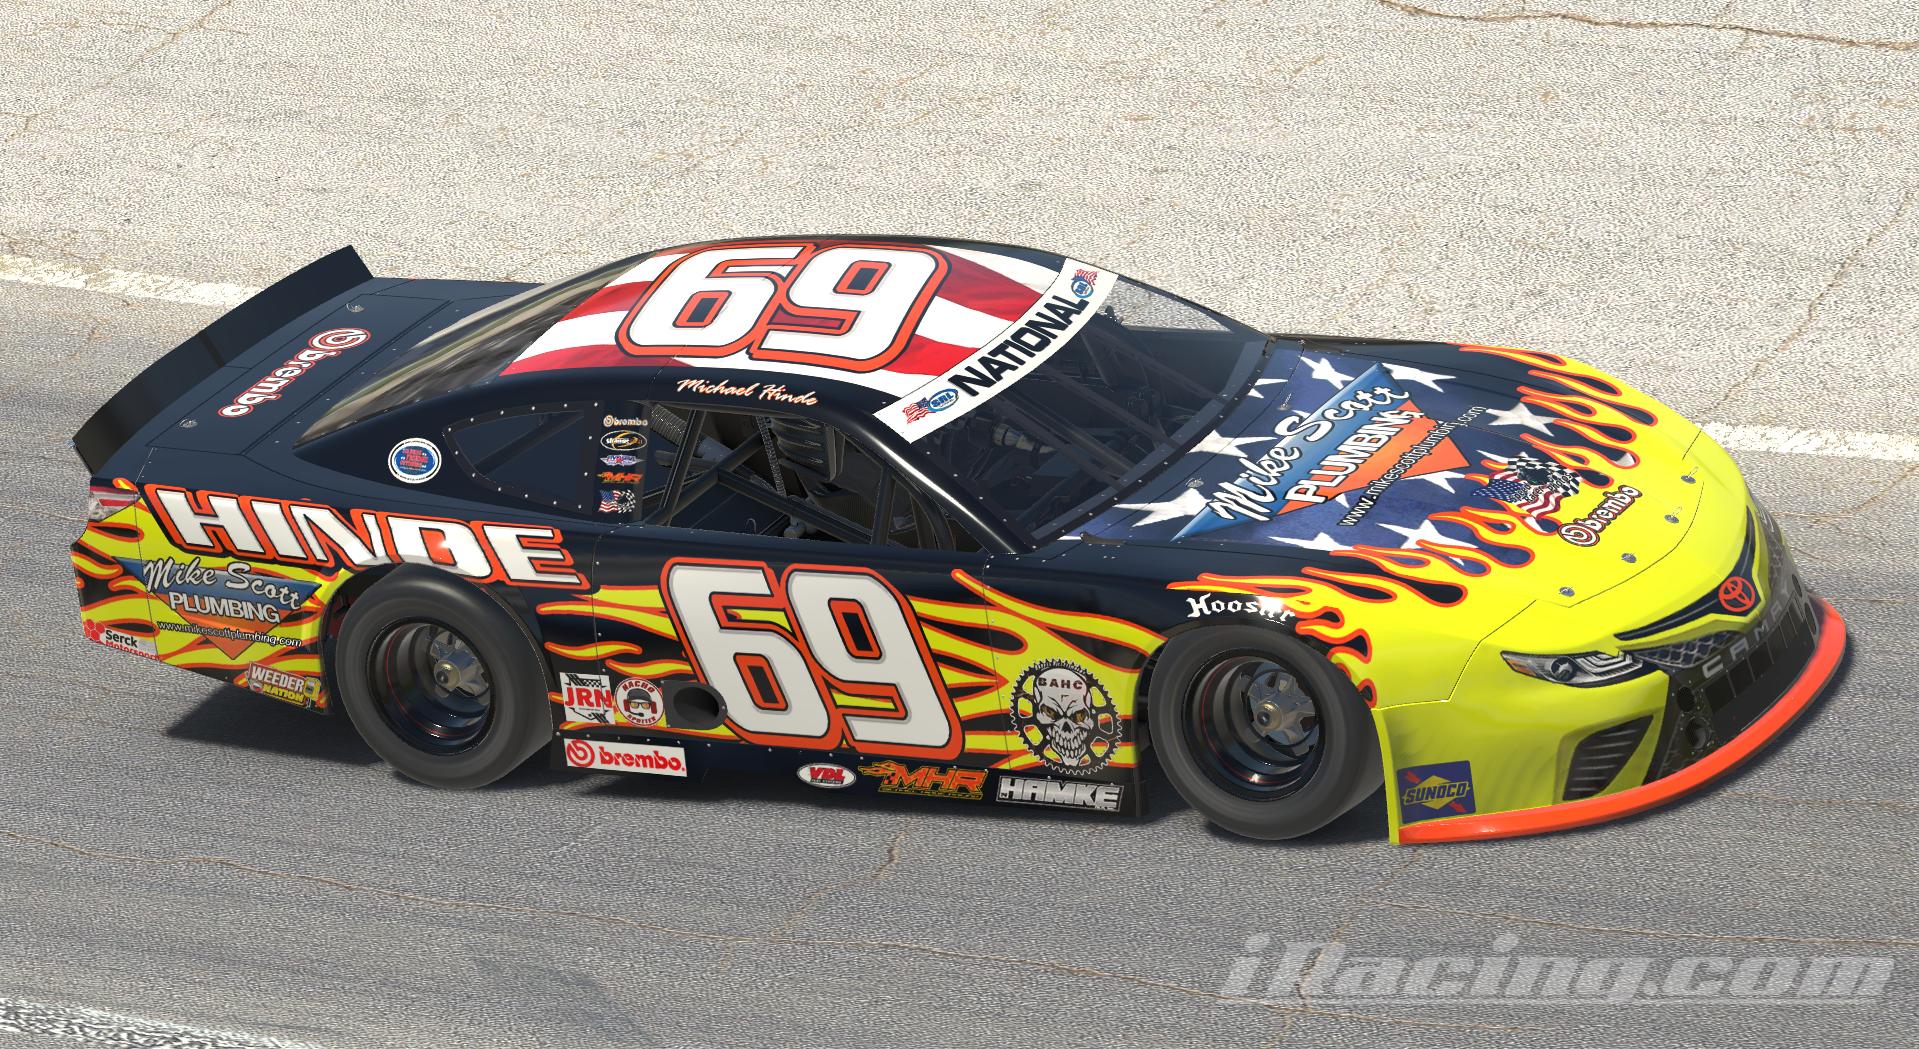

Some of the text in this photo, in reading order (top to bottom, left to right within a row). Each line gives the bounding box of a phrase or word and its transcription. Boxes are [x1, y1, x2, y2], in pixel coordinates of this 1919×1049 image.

[615, 242, 951, 373] 69
[947, 295, 1090, 397] NATIONAL
[218, 347, 342, 418] brembo
[676, 378, 818, 406] Michael Hinde
[930, 392, 954, 408] SRL
[613, 417, 648, 427] brembo
[1207, 384, 1410, 522] Mike Scott
[1283, 409, 1425, 504] PLUMBING
[1574, 485, 1642, 532] brembo
[145, 483, 591, 588] HINDE
[143, 557, 302, 610] Mike Scott
[169, 592, 281, 624] PLUMBING
[105, 629, 138, 648] Serck
[156, 621, 303, 648] www.mikescottplumbing.com
[660, 557, 965, 761] 69
[251, 665, 305, 693] WEEDER
[262, 684, 305, 703] NATION
[621, 681, 656, 693] NACHO
[1037, 677, 1083, 690] BAHC
[564, 686, 613, 709] JRN
[890, 762, 988, 793] MHR
[1405, 782, 1468, 803] SUNOCO
[999, 777, 1121, 810] HAMKE
